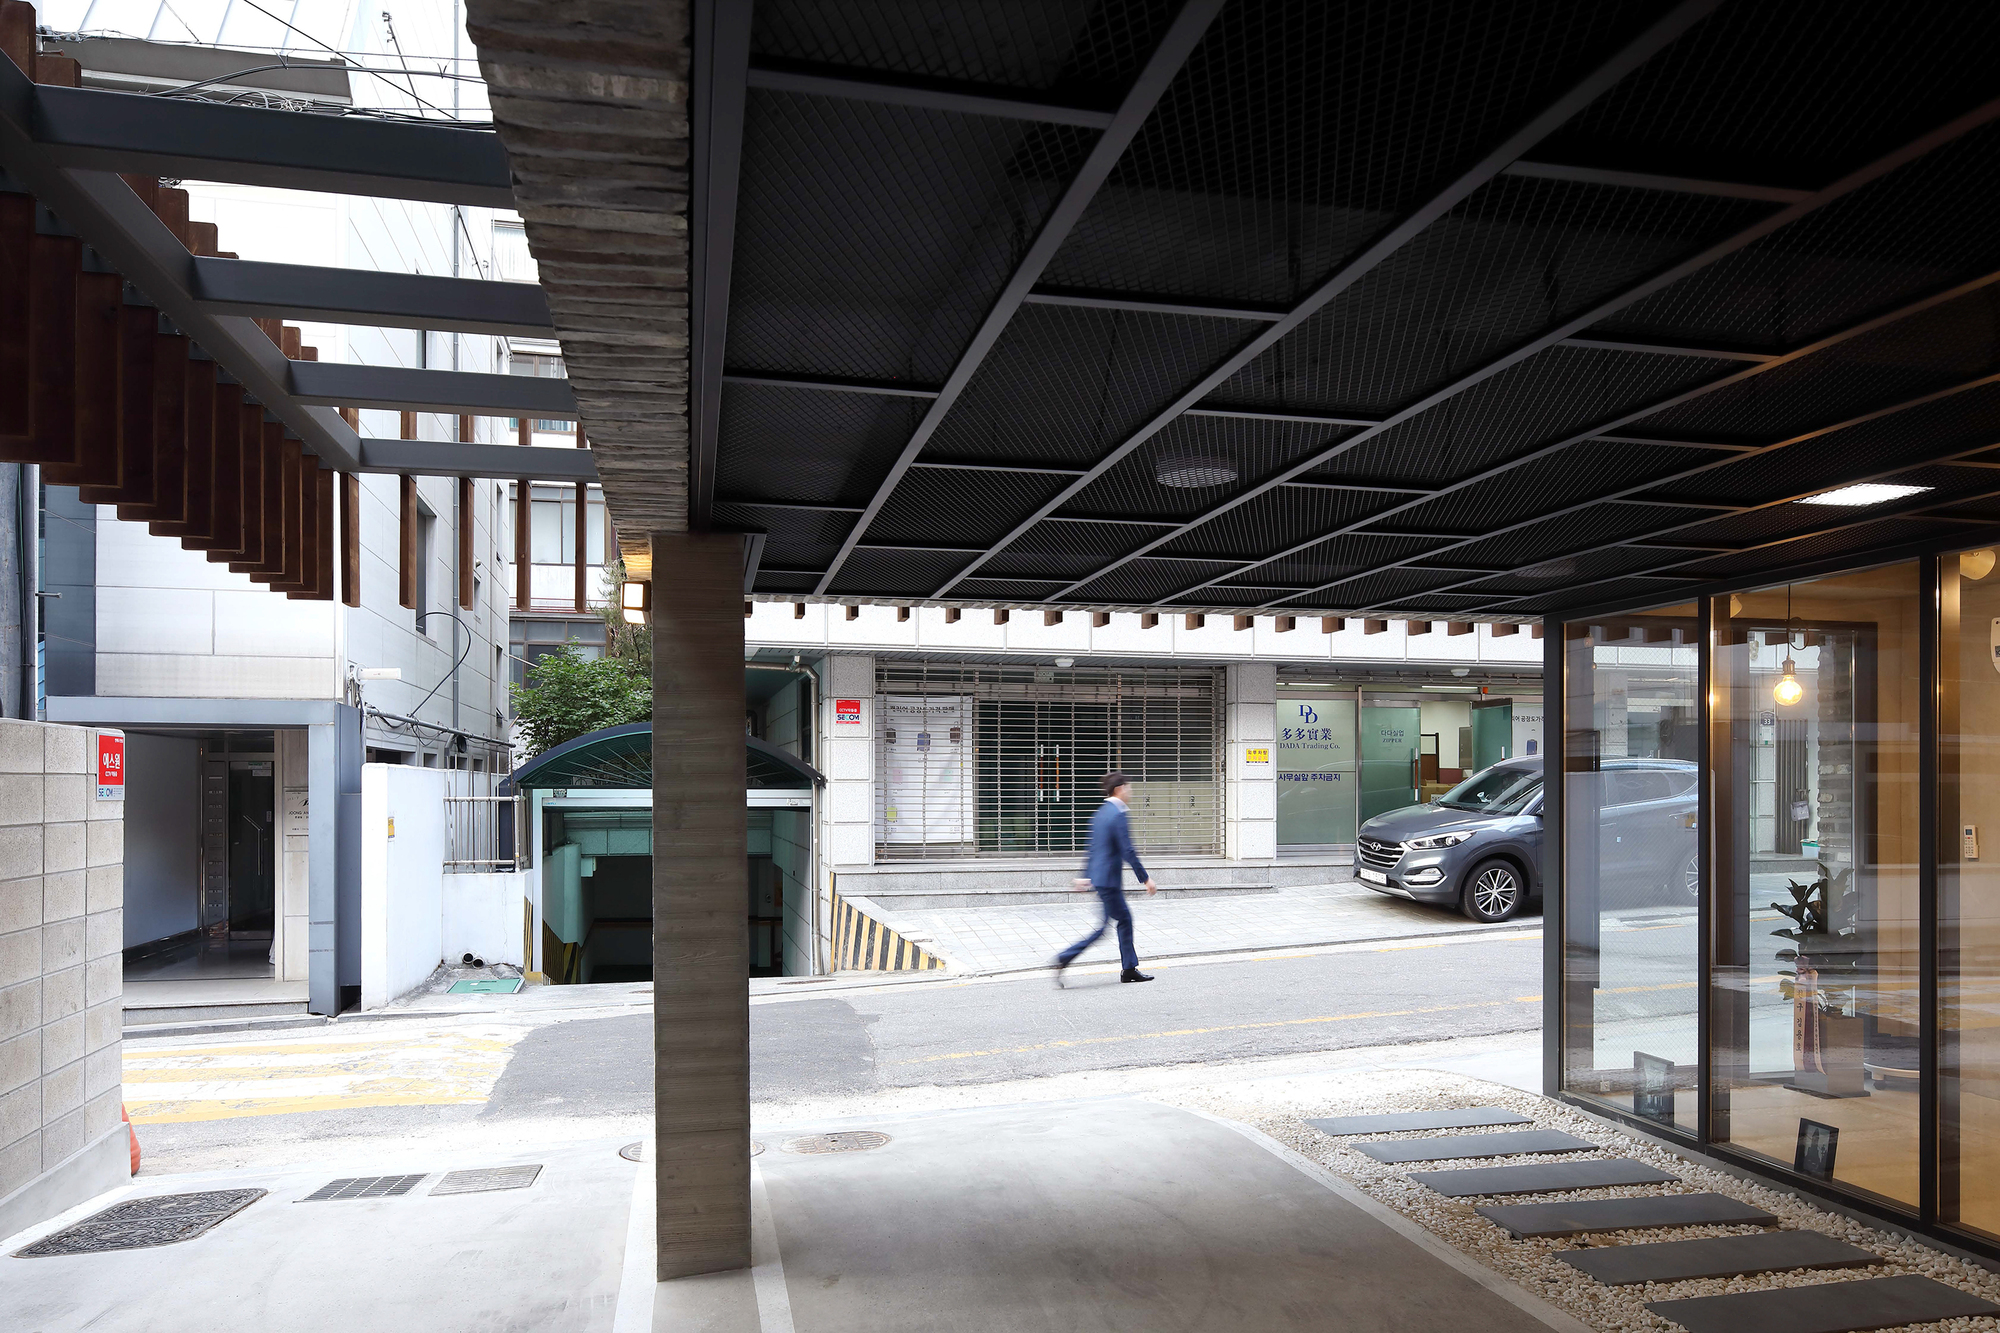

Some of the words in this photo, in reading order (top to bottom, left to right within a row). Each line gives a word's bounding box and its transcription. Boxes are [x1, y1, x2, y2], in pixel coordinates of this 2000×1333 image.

[1281, 727, 1332, 741] 多多實業
[1380, 729, 1404, 737] 다다실업
[1301, 742, 1329, 750] Trading
[102, 752, 121, 769] 에스원
[1278, 773, 1309, 782] 사무실앞
[1310, 773, 1341, 782] 주차금지
